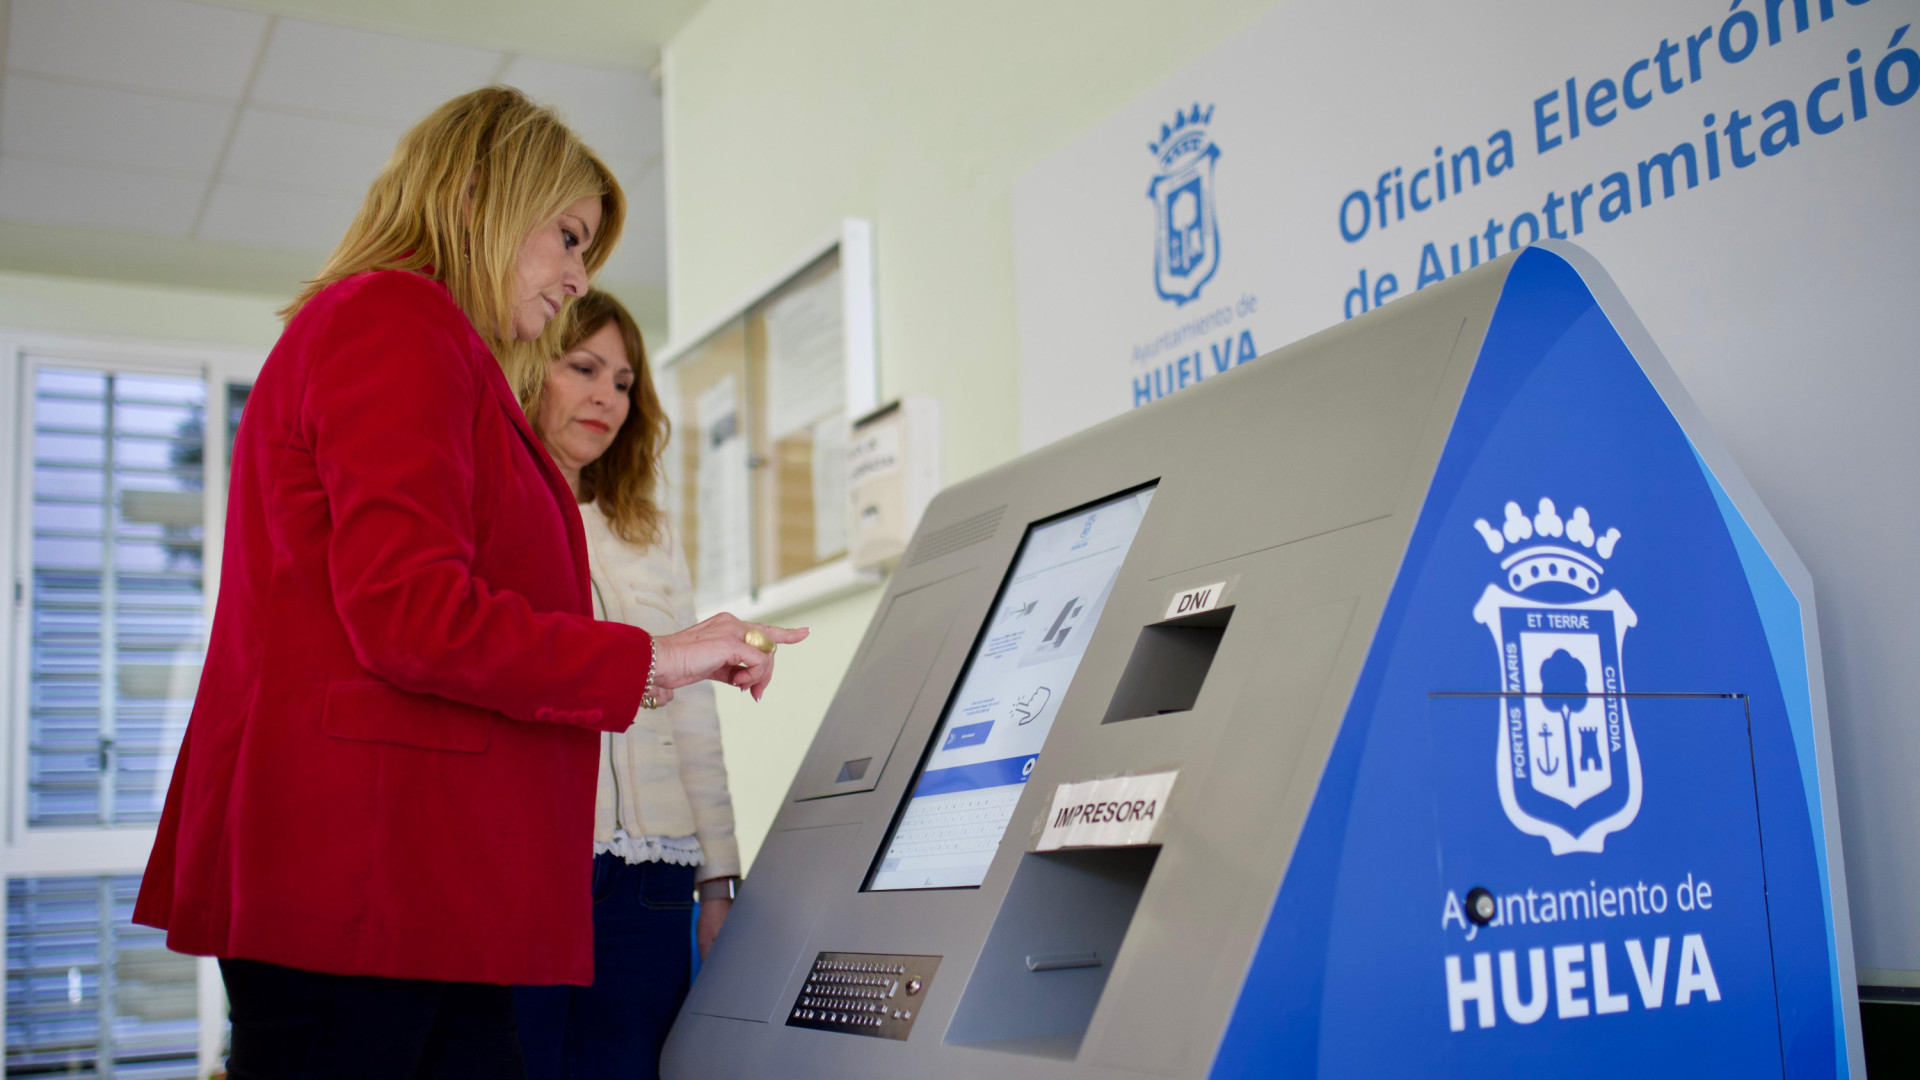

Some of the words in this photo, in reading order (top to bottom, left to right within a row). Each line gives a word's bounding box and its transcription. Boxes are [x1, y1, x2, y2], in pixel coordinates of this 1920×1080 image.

[1338, 129, 1515, 243] Oficina
[1532, 0, 1873, 155] Electrón
[1344, 269, 1398, 319] de
[1132, 329, 1257, 408] HUELVA
[1176, 589, 1212, 614] DNI
[1527, 613, 1542, 628] ET
[1510, 707, 1527, 778] PORTUS
[1054, 800, 1156, 828] IMPRESORA
[1677, 872, 1713, 912] de
[1445, 933, 1721, 1032] HUELVA
